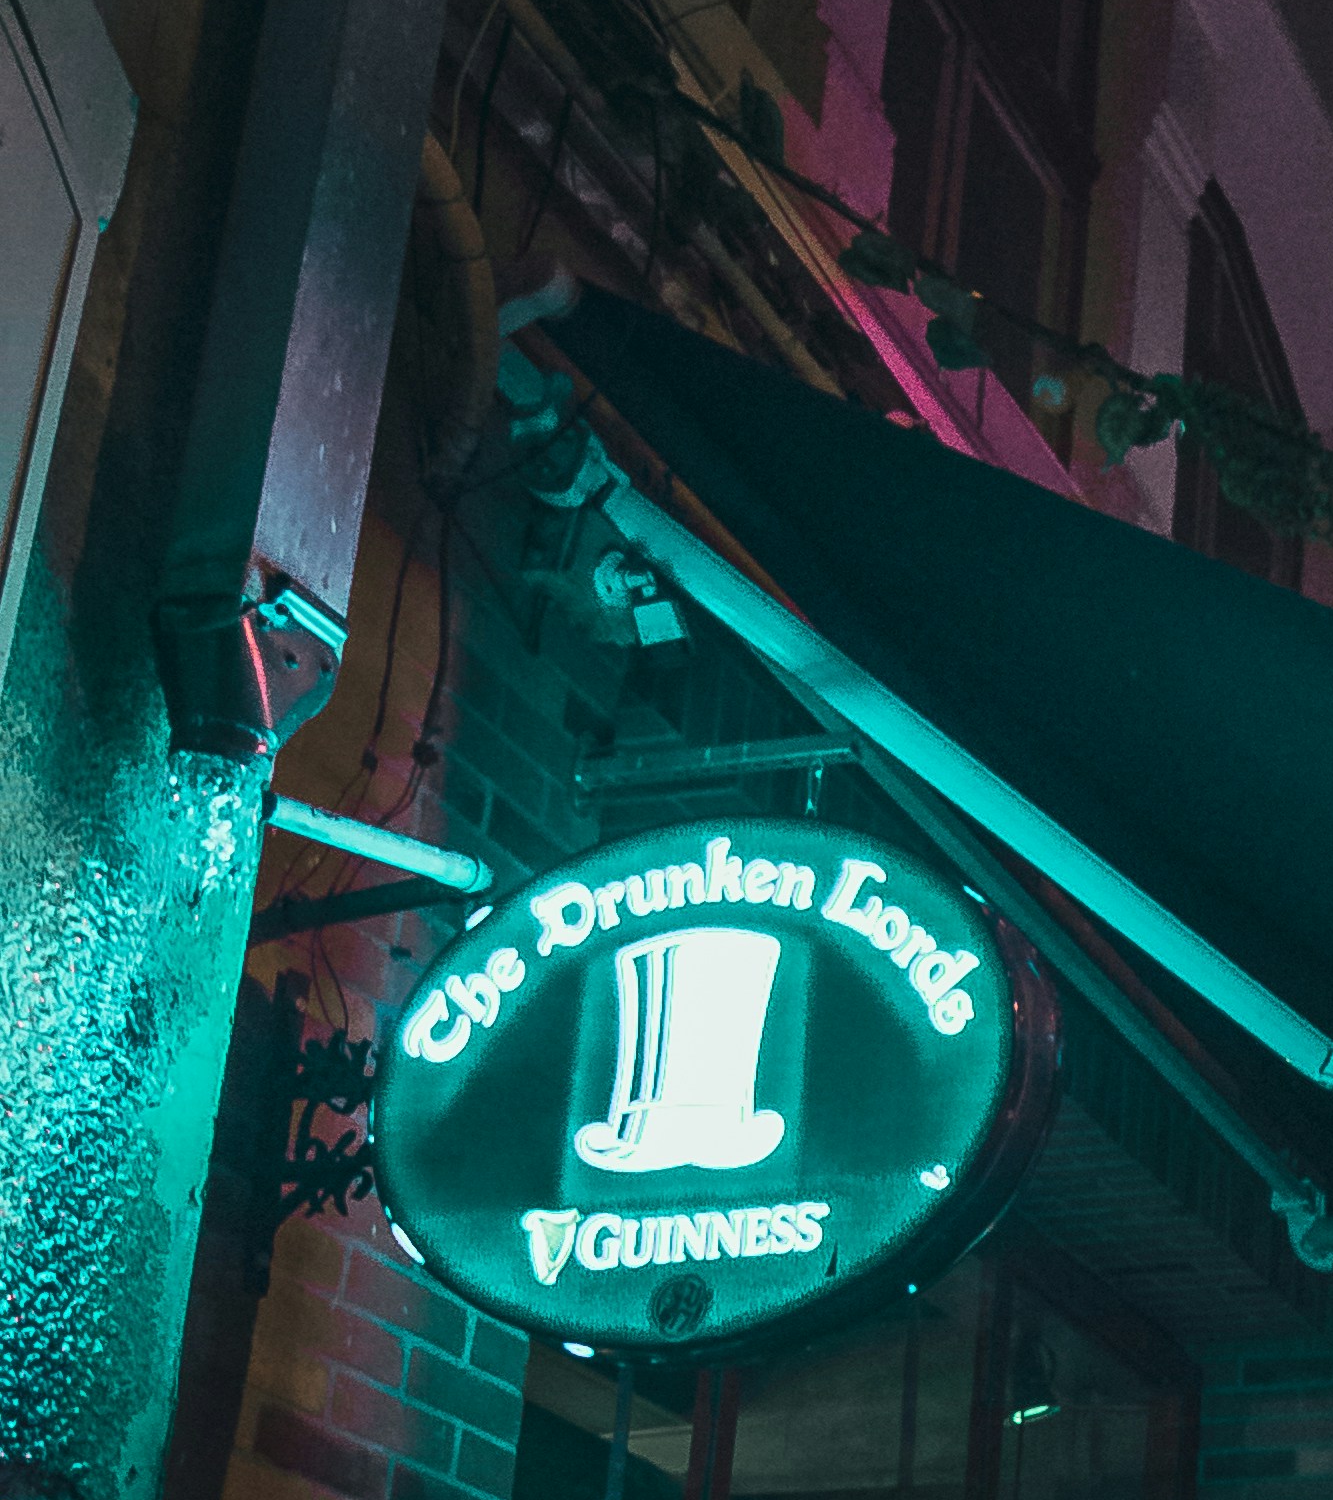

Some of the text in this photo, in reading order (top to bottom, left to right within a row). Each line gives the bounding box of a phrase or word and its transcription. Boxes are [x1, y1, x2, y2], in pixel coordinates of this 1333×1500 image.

[403, 836, 982, 1064] The Drunken Lords
[574, 1202, 831, 1272] GUINNESS
